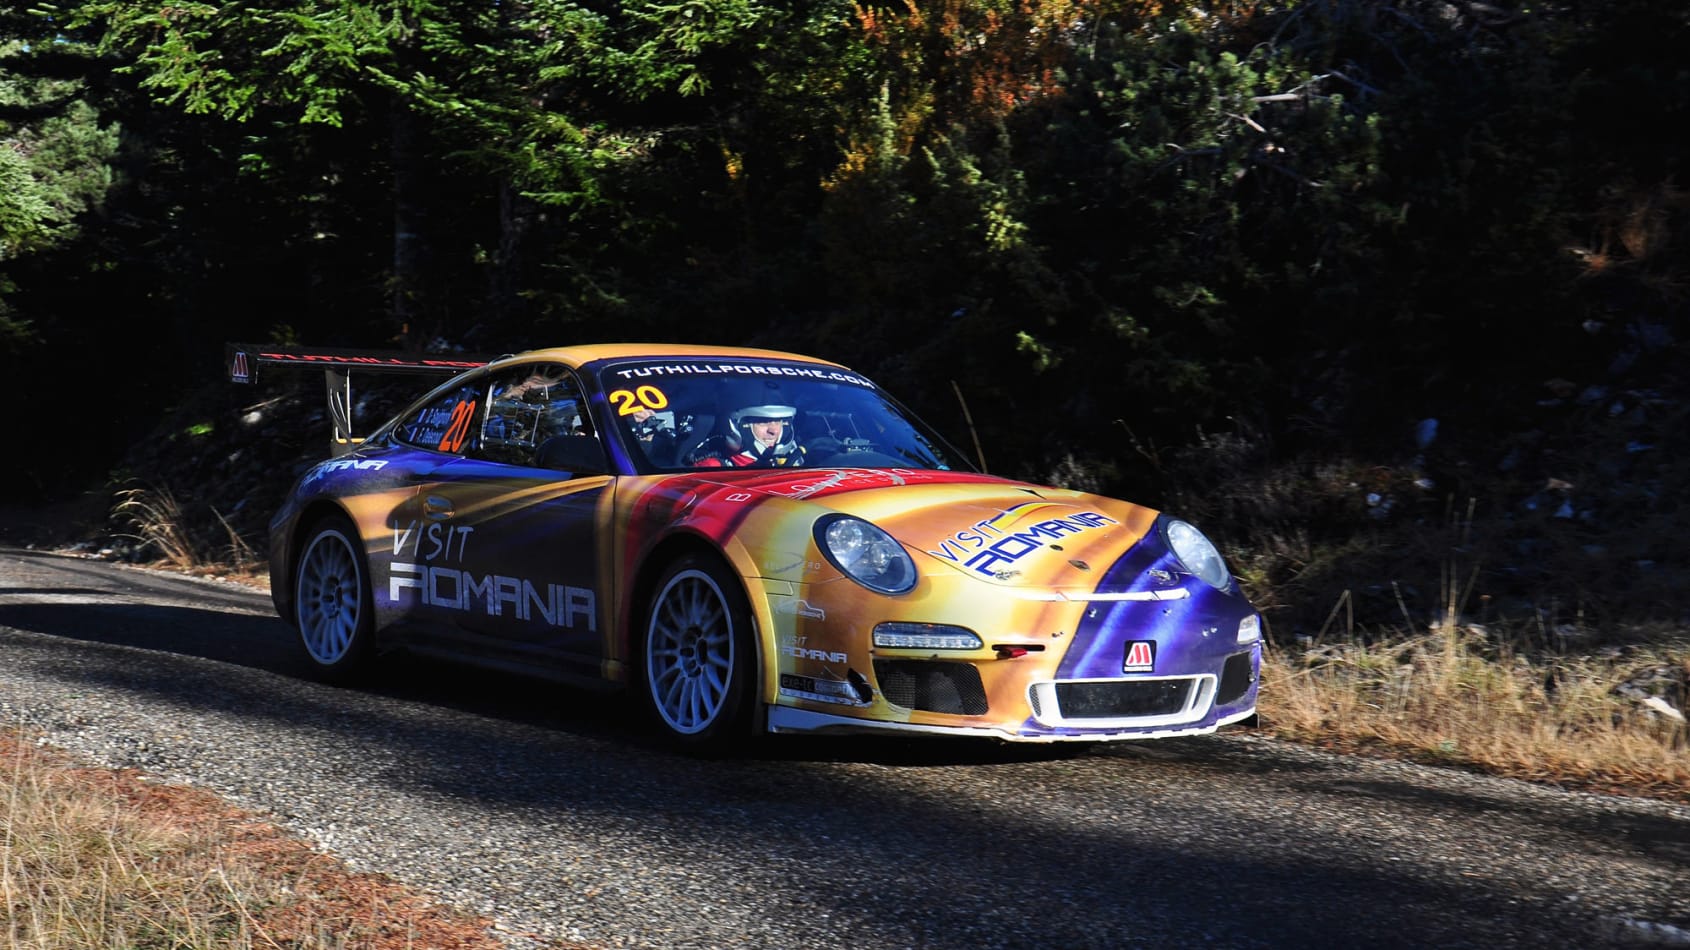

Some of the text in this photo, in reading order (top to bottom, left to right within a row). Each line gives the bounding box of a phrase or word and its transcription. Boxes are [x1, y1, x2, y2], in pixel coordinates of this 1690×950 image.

[617, 365, 876, 389] TUTHILLPORSCHE.COM
[609, 385, 669, 416] 20
[438, 400, 476, 452] 20
[393, 519, 474, 563] VISIT
[929, 519, 1004, 562] VISIT
[963, 511, 1118, 577] ROMANIA
[389, 561, 597, 632] ROMANIA
[782, 645, 848, 664] ROMANIA
